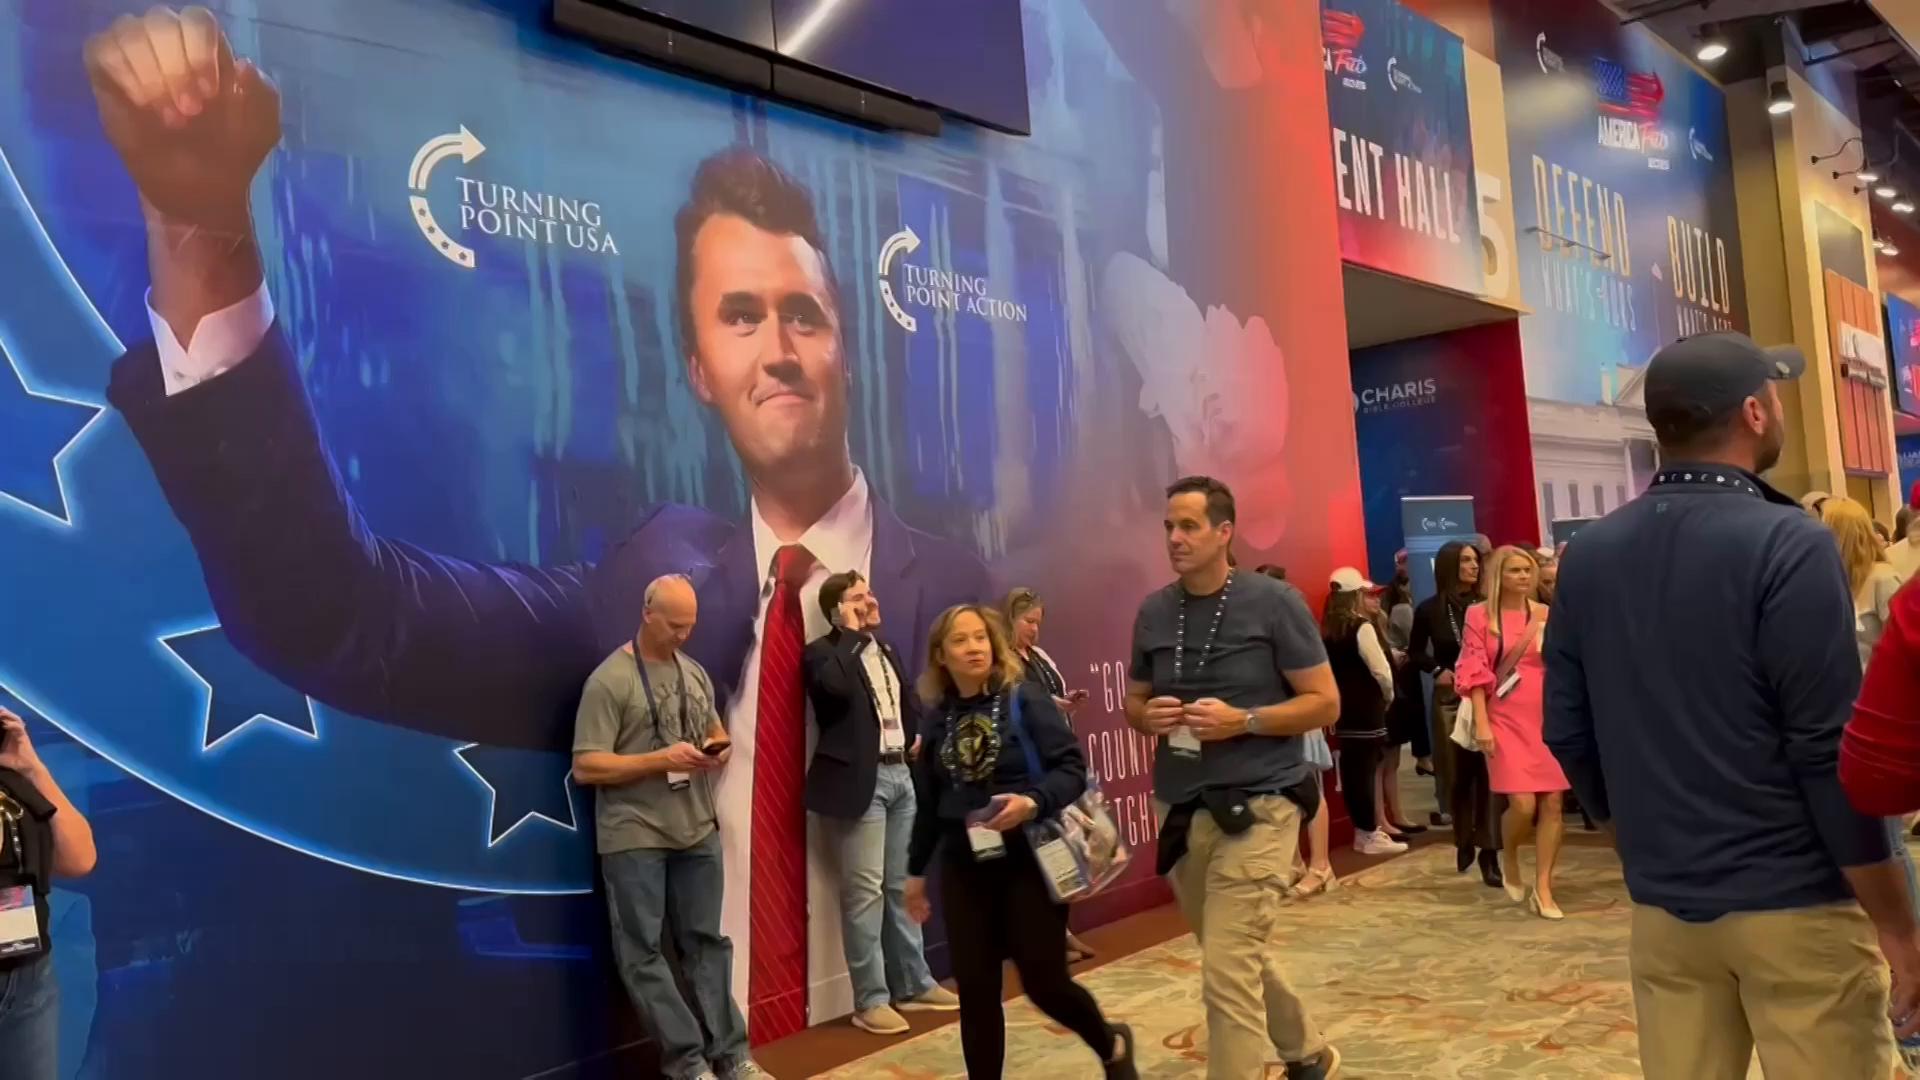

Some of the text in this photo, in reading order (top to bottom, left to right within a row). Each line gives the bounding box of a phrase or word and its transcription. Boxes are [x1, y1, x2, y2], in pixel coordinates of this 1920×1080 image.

[455, 175, 601, 227] TURNING
[1333, 127, 1461, 244] ENT HALL
[460, 204, 621, 256] POINT USA
[1476, 171, 1510, 298] 5
[1532, 154, 1631, 277] DEFEND
[902, 263, 987, 296] TURNING
[1667, 215, 1730, 314] BUILD
[906, 285, 1028, 322] POINT ACTION
[1361, 378, 1437, 405] CHARIS
